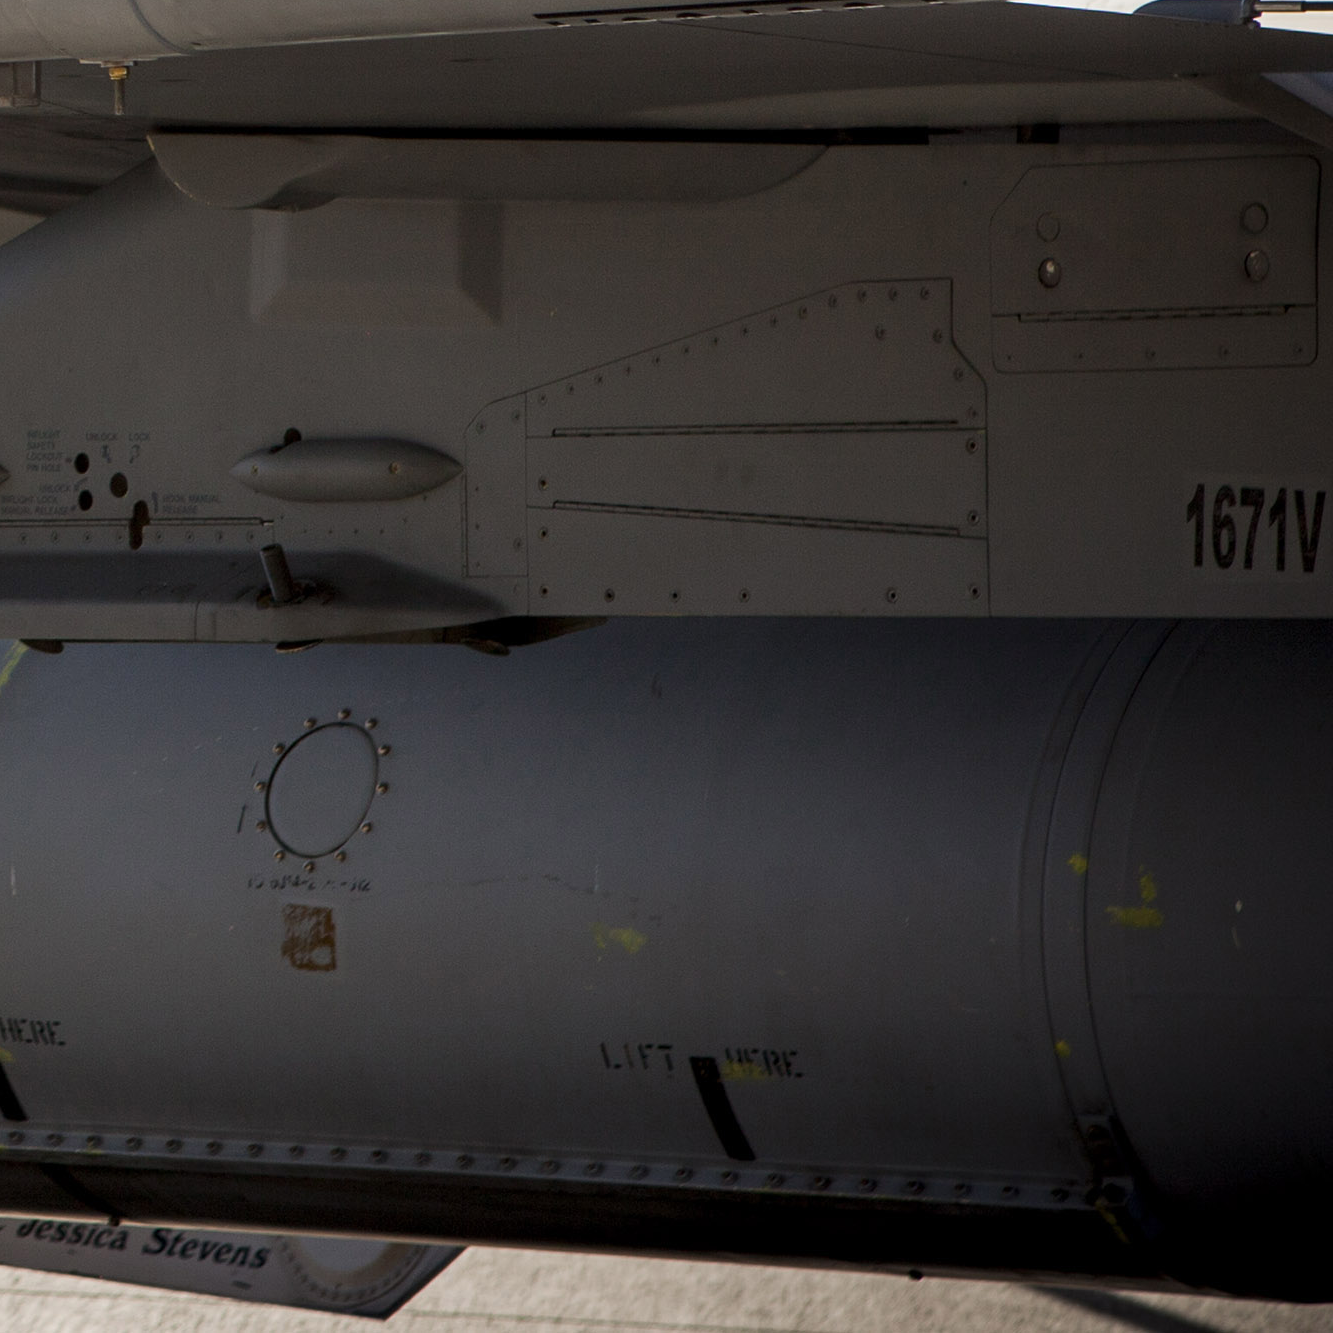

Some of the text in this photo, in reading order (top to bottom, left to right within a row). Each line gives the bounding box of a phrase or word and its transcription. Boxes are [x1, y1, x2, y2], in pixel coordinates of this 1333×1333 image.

[85, 432, 118, 441] UNLOCK
[128, 432, 150, 441] LOCK
[41, 463, 62, 472] HOLE
[37, 495, 59, 504] LOCK
[1186, 482, 1326, 573] 1671V
[600, 1041, 803, 1078] LIFT HERE
[16, 1219, 129, 1251] Jessica
[142, 1227, 273, 1269] Stevens
